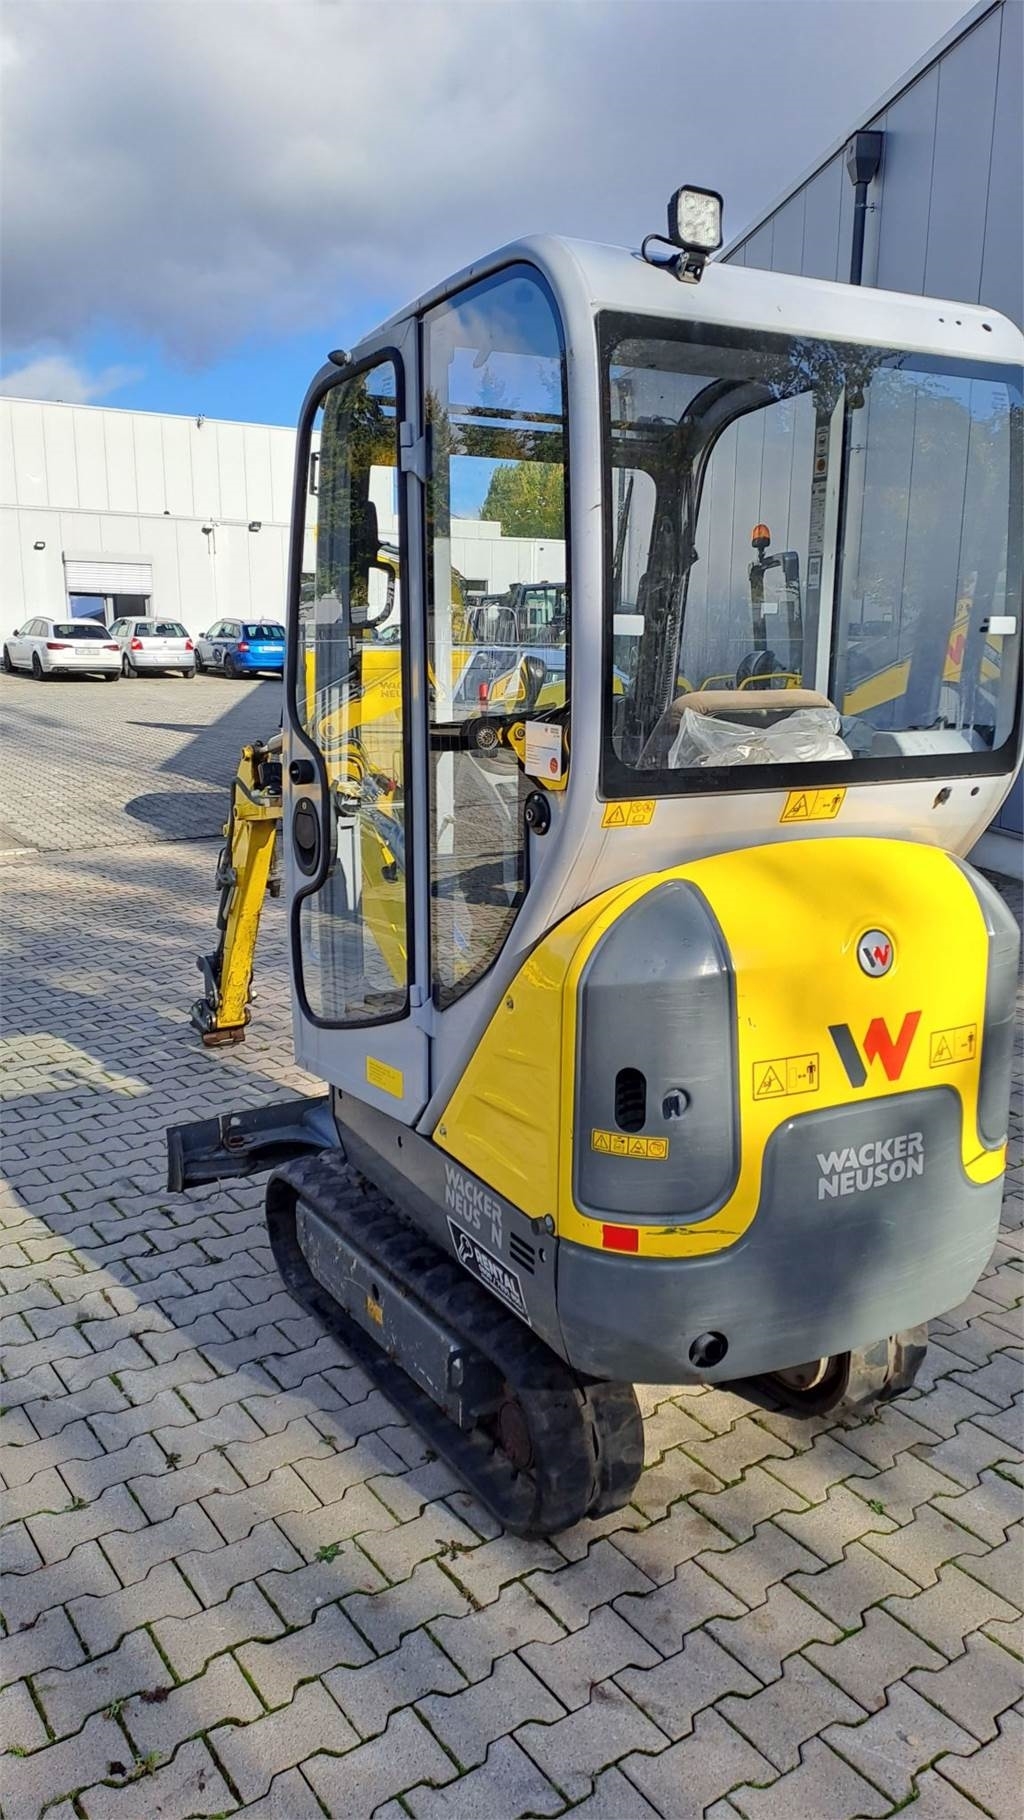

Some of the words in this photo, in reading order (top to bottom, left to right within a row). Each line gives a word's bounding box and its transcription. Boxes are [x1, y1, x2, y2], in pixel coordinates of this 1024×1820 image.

[816, 1131, 925, 1176] WACKER
[818, 1153, 925, 1200] NEUSON
[445, 1162, 503, 1227] WACKER
[474, 1246, 521, 1299] RENTAL
